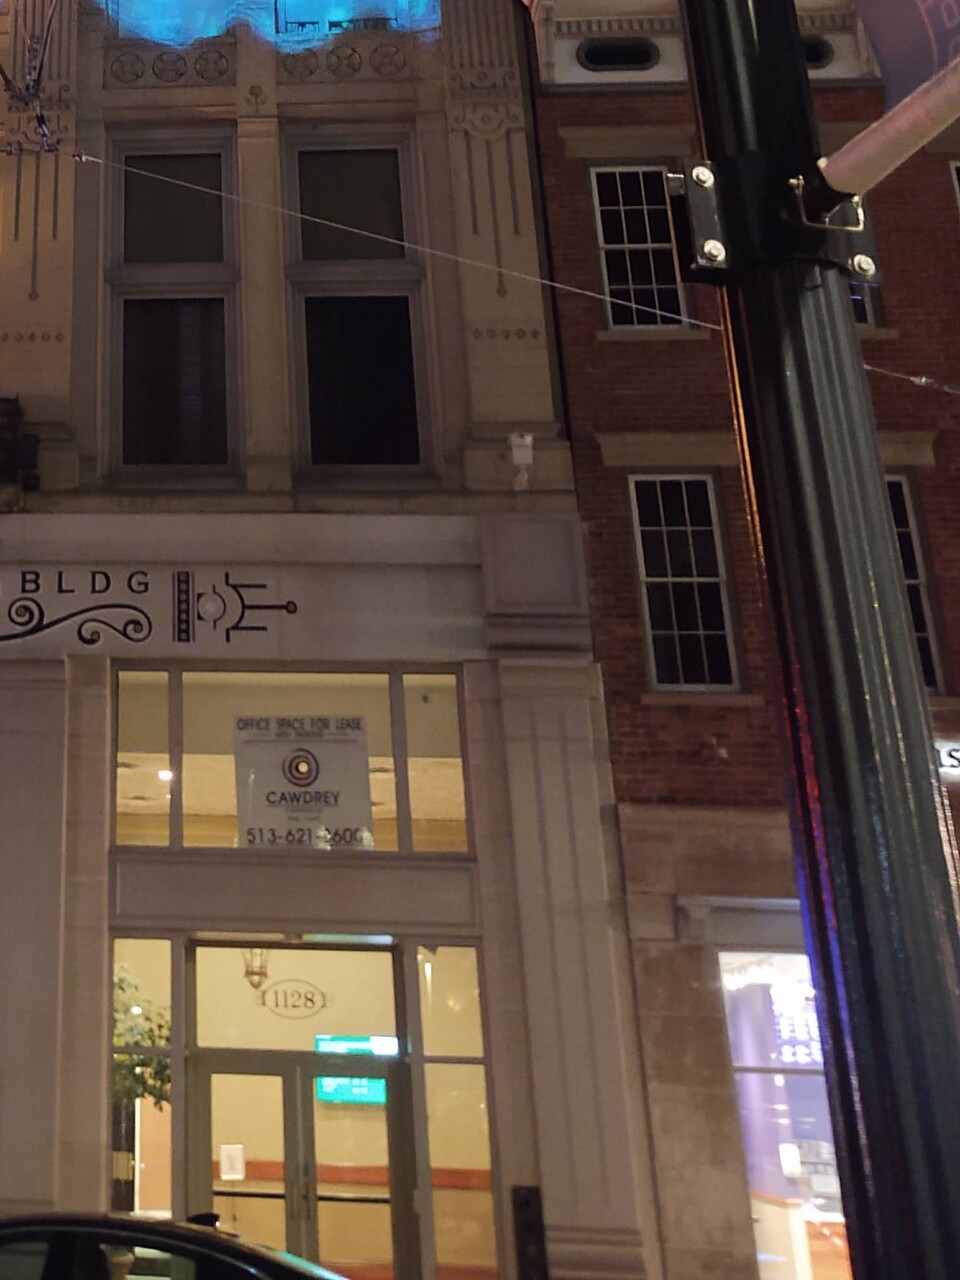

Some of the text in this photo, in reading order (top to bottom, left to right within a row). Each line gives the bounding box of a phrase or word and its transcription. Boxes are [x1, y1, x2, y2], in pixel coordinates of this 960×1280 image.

[20, 571, 150, 594] BLDG
[236, 718, 362, 730] OFFICE SPACE FOR LEASE
[266, 791, 340, 804] CAWDREY
[274, 990, 316, 1008] 1128
